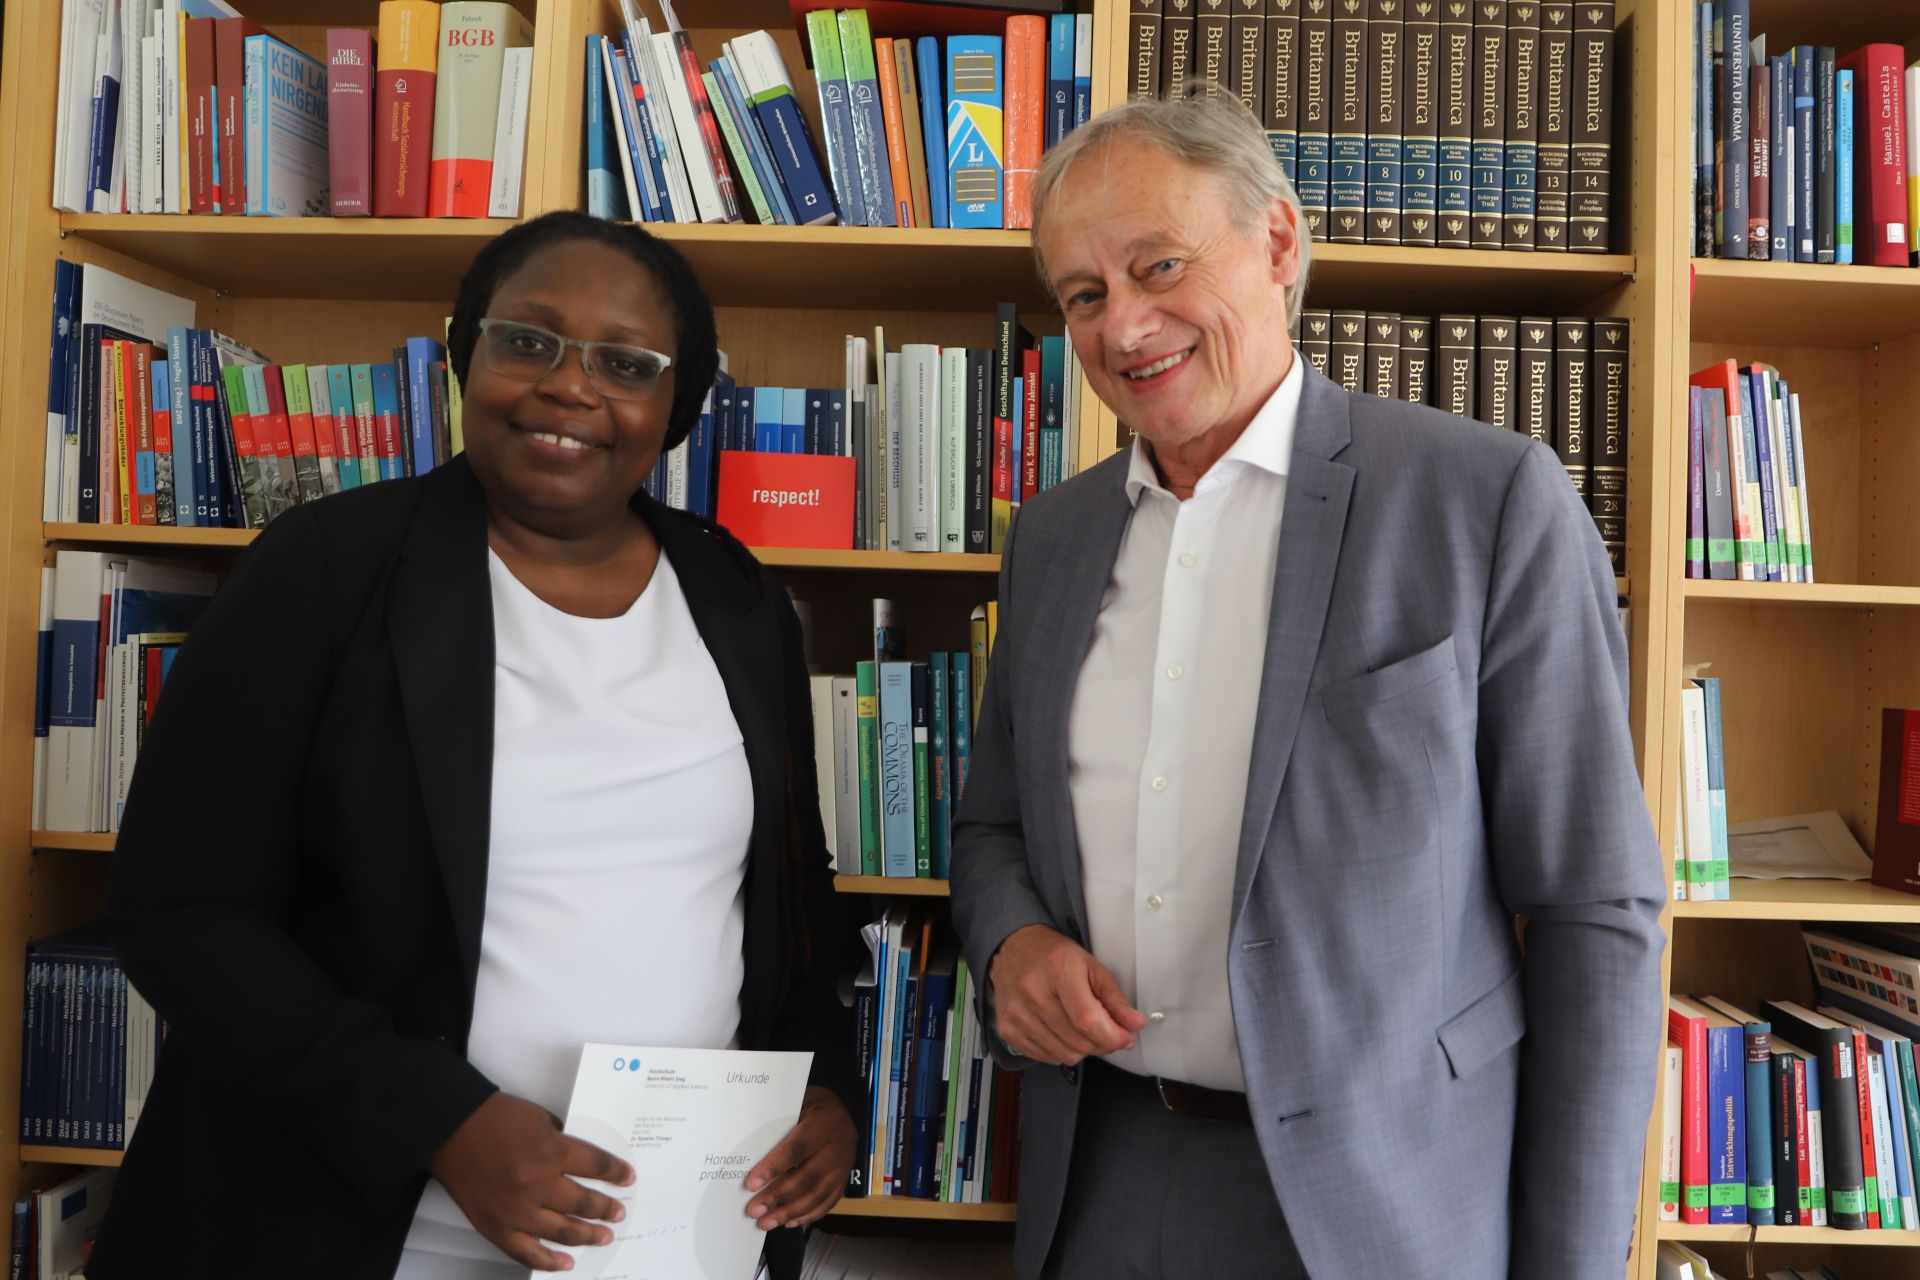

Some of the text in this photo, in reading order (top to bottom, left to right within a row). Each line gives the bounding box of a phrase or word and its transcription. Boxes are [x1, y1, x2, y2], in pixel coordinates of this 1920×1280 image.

[337, 49, 357, 58] DIE
[447, 29, 495, 47] BGB
[1732, 14, 1743, 88] L'UNIVERSITÀ
[272, 47, 304, 84] KEIN
[332, 56, 364, 66] BIBEL
[1275, 27, 1293, 118] Britannica
[1308, 30, 1326, 121] Britannica
[1344, 30, 1361, 122] Britannica
[1380, 31, 1396, 123] Britannica
[1416, 32, 1433, 124] Britannica
[1450, 34, 1467, 126] Britannica
[1483, 36, 1500, 128] Britannica
[1517, 38, 1534, 130] Britannica
[1548, 41, 1566, 132] Britannica
[1587, 40, 1604, 132] Britannica
[1732, 92, 1741, 104] DI
[1881, 65, 1892, 166] Manuel Castells
[402, 101, 412, 134] Handbuch
[1732, 108, 1741, 142] ROMA
[968, 142, 984, 163] L
[1309, 165, 1316, 176] 6
[1346, 166, 1353, 176] 7
[1382, 166, 1389, 178] 8
[1417, 168, 1424, 180] 9
[1450, 170, 1462, 182] 10
[1482, 172, 1494, 183] 11
[1515, 174, 1528, 185] 12
[1547, 176, 1559, 188] 13
[1585, 176, 1597, 187] 14
[1000, 366, 1008, 417] Geschäftsplan
[1493, 357, 1509, 427] Britann
[1530, 360, 1546, 443] Britannic
[1568, 360, 1584, 454] Britannica
[1606, 362, 1622, 455] Britannica
[1029, 422, 1034, 430] im
[1027, 454, 1032, 464] K.
[752, 488, 820, 507] respect!
[1604, 500, 1618, 512] 28
[884, 722, 900, 816] COMMONS
[899, 722, 908, 815] THE DRAMA OF THE
[935, 756, 943, 800] Biodiversity
[726, 1072, 770, 1084] Urkunde
[1726, 1095, 1734, 1179] Entwicklungspolitik
[704, 1154, 750, 1166] Honorar-
